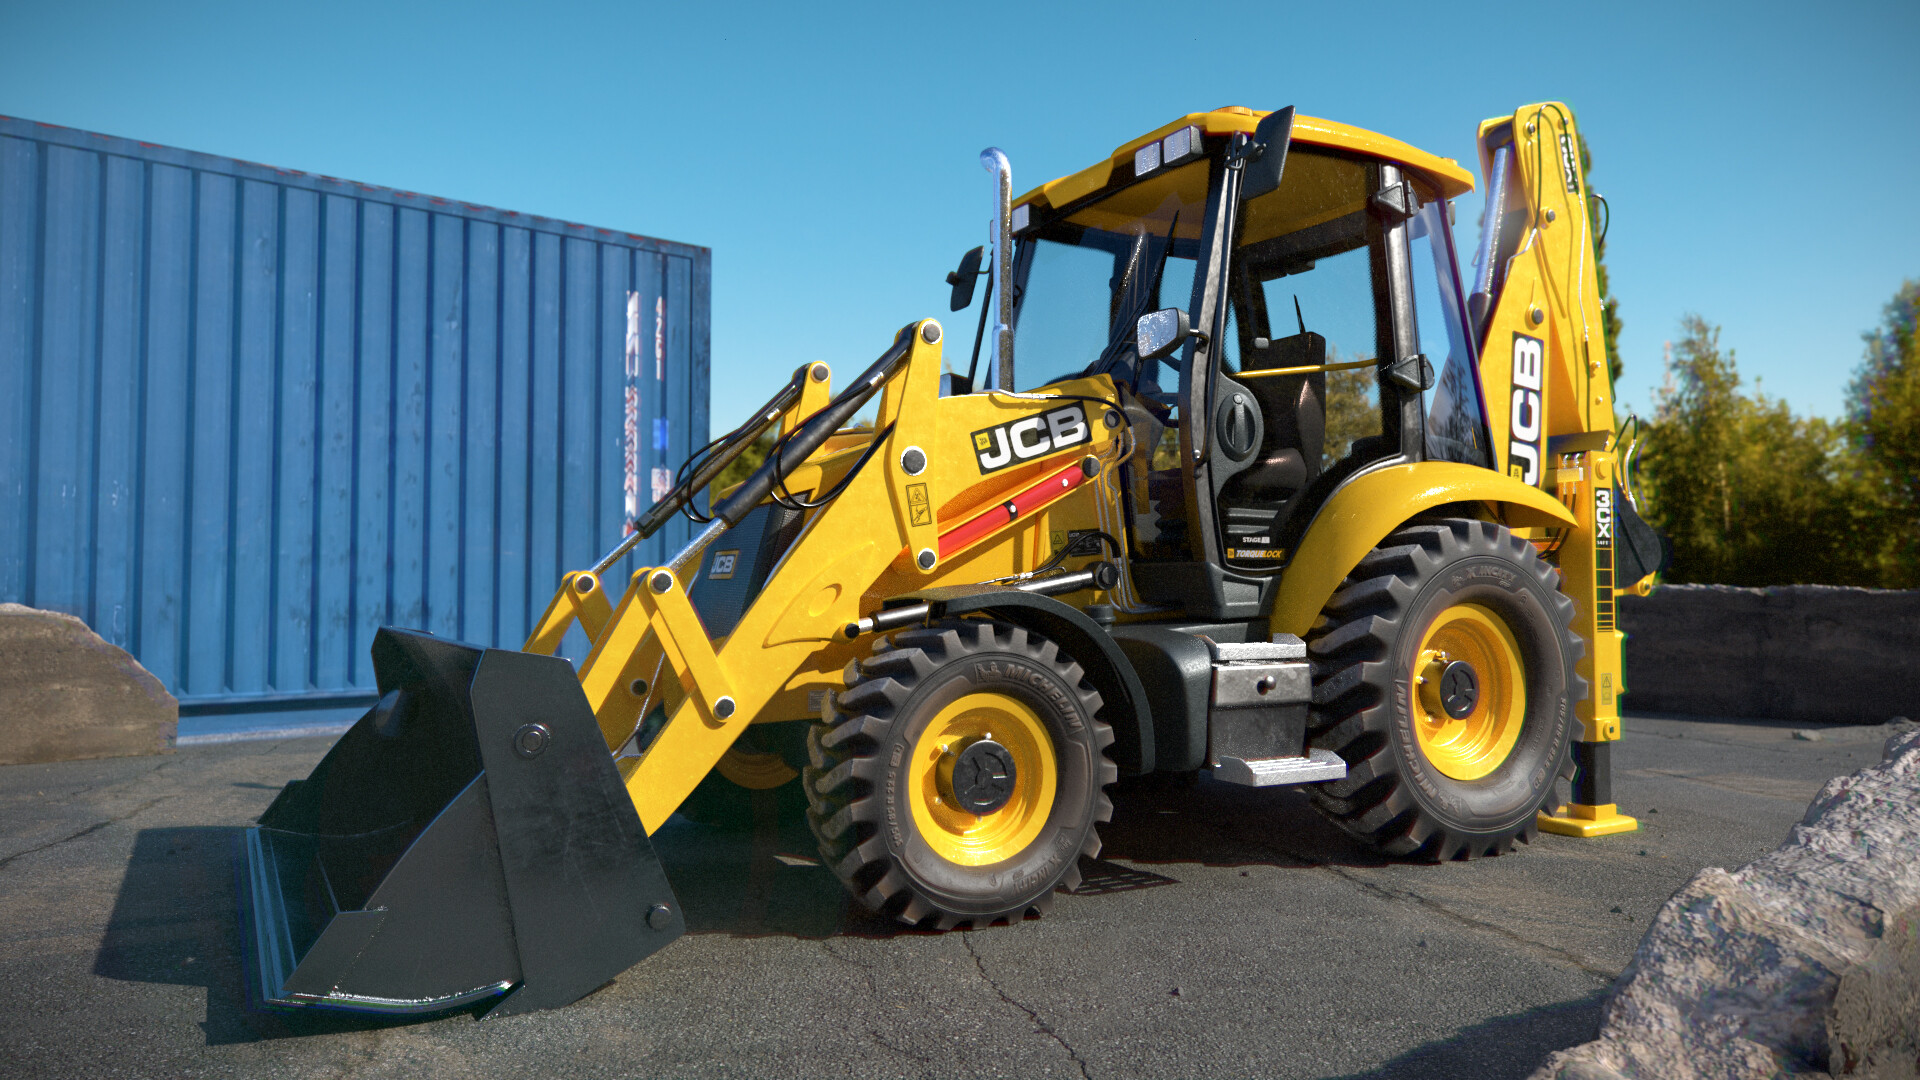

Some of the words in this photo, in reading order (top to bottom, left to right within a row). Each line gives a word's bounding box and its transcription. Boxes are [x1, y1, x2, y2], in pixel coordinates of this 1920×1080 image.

[980, 406, 1088, 469] JCB
[1511, 337, 1541, 486] JCB
[1596, 490, 1610, 538] 3CX
[711, 555, 735, 573] JCB
[1236, 549, 1282, 558] TORQUELOCK
[1005, 663, 1082, 728] MICHELIN
[1396, 681, 1438, 800] MICHELIN
